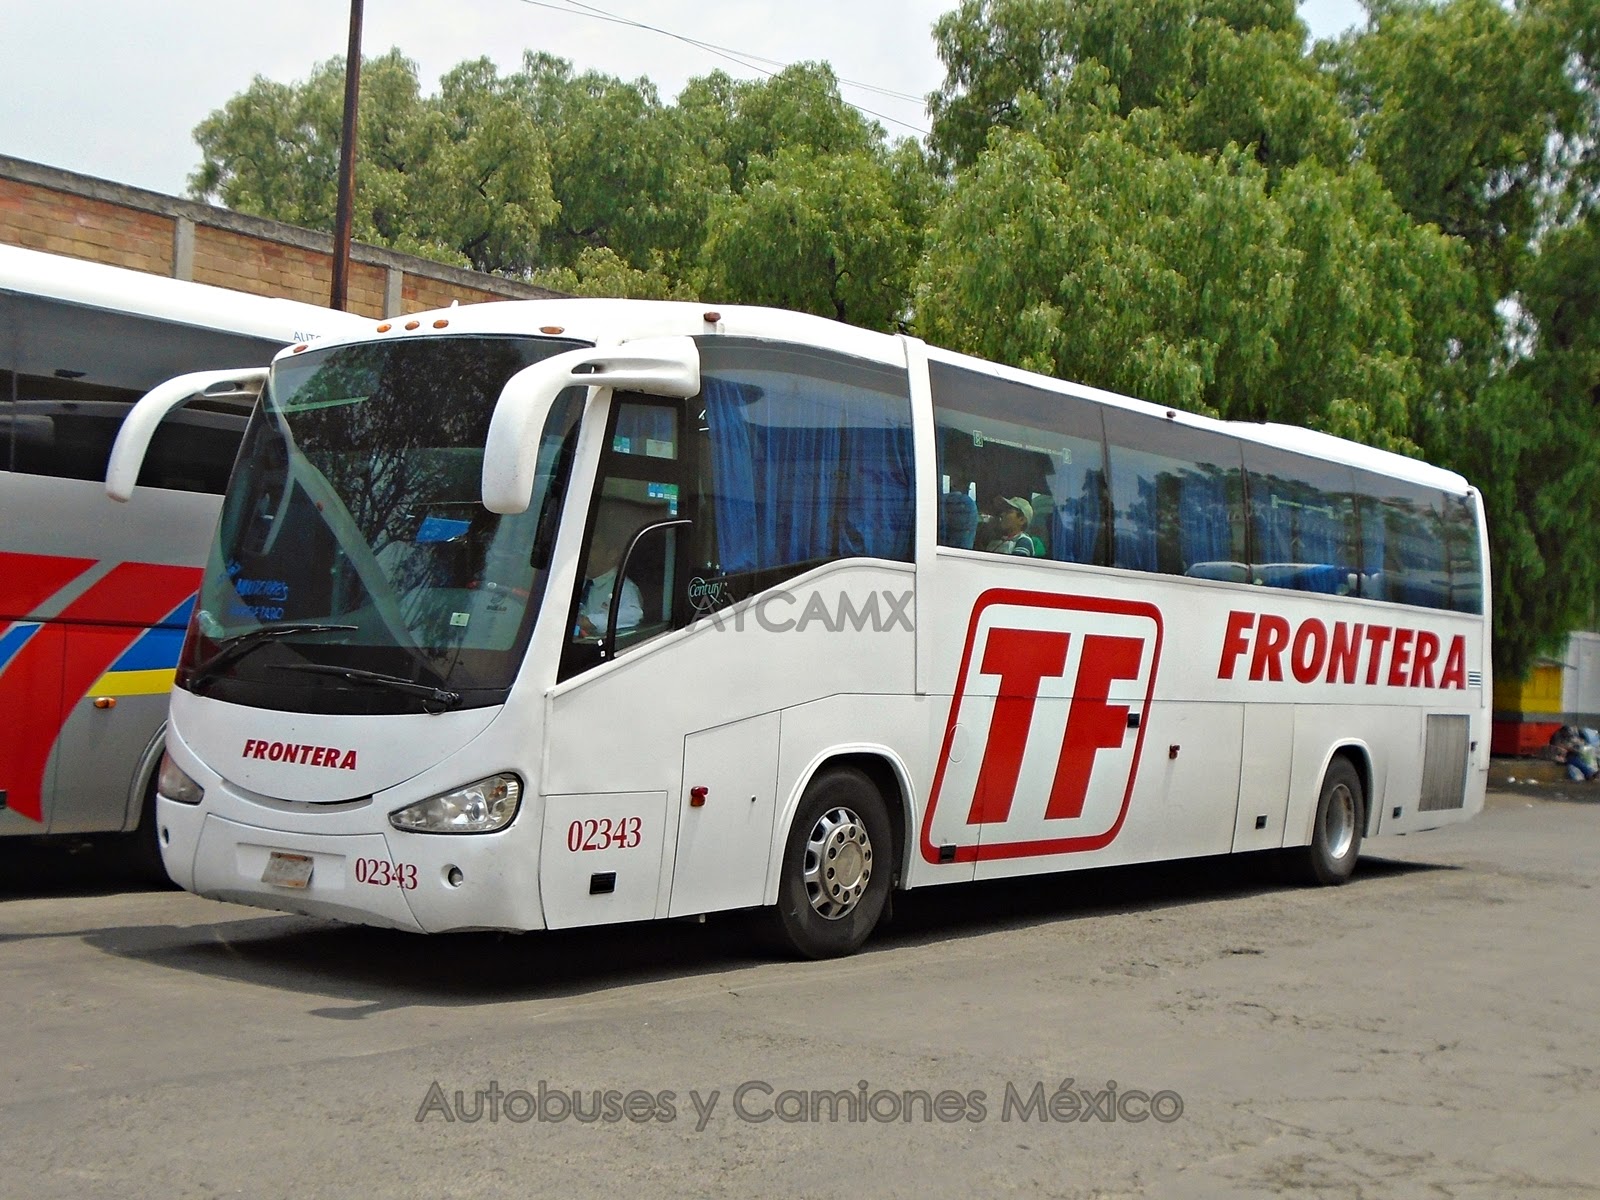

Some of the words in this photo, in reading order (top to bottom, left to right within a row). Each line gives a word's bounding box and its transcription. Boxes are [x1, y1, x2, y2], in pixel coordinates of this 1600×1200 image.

[1220, 610, 1466, 690] FRONTERA
[966, 627, 1146, 825] TF
[242, 739, 358, 771] FRONTERA
[567, 816, 642, 853] 02343
[355, 857, 419, 890] 02343
